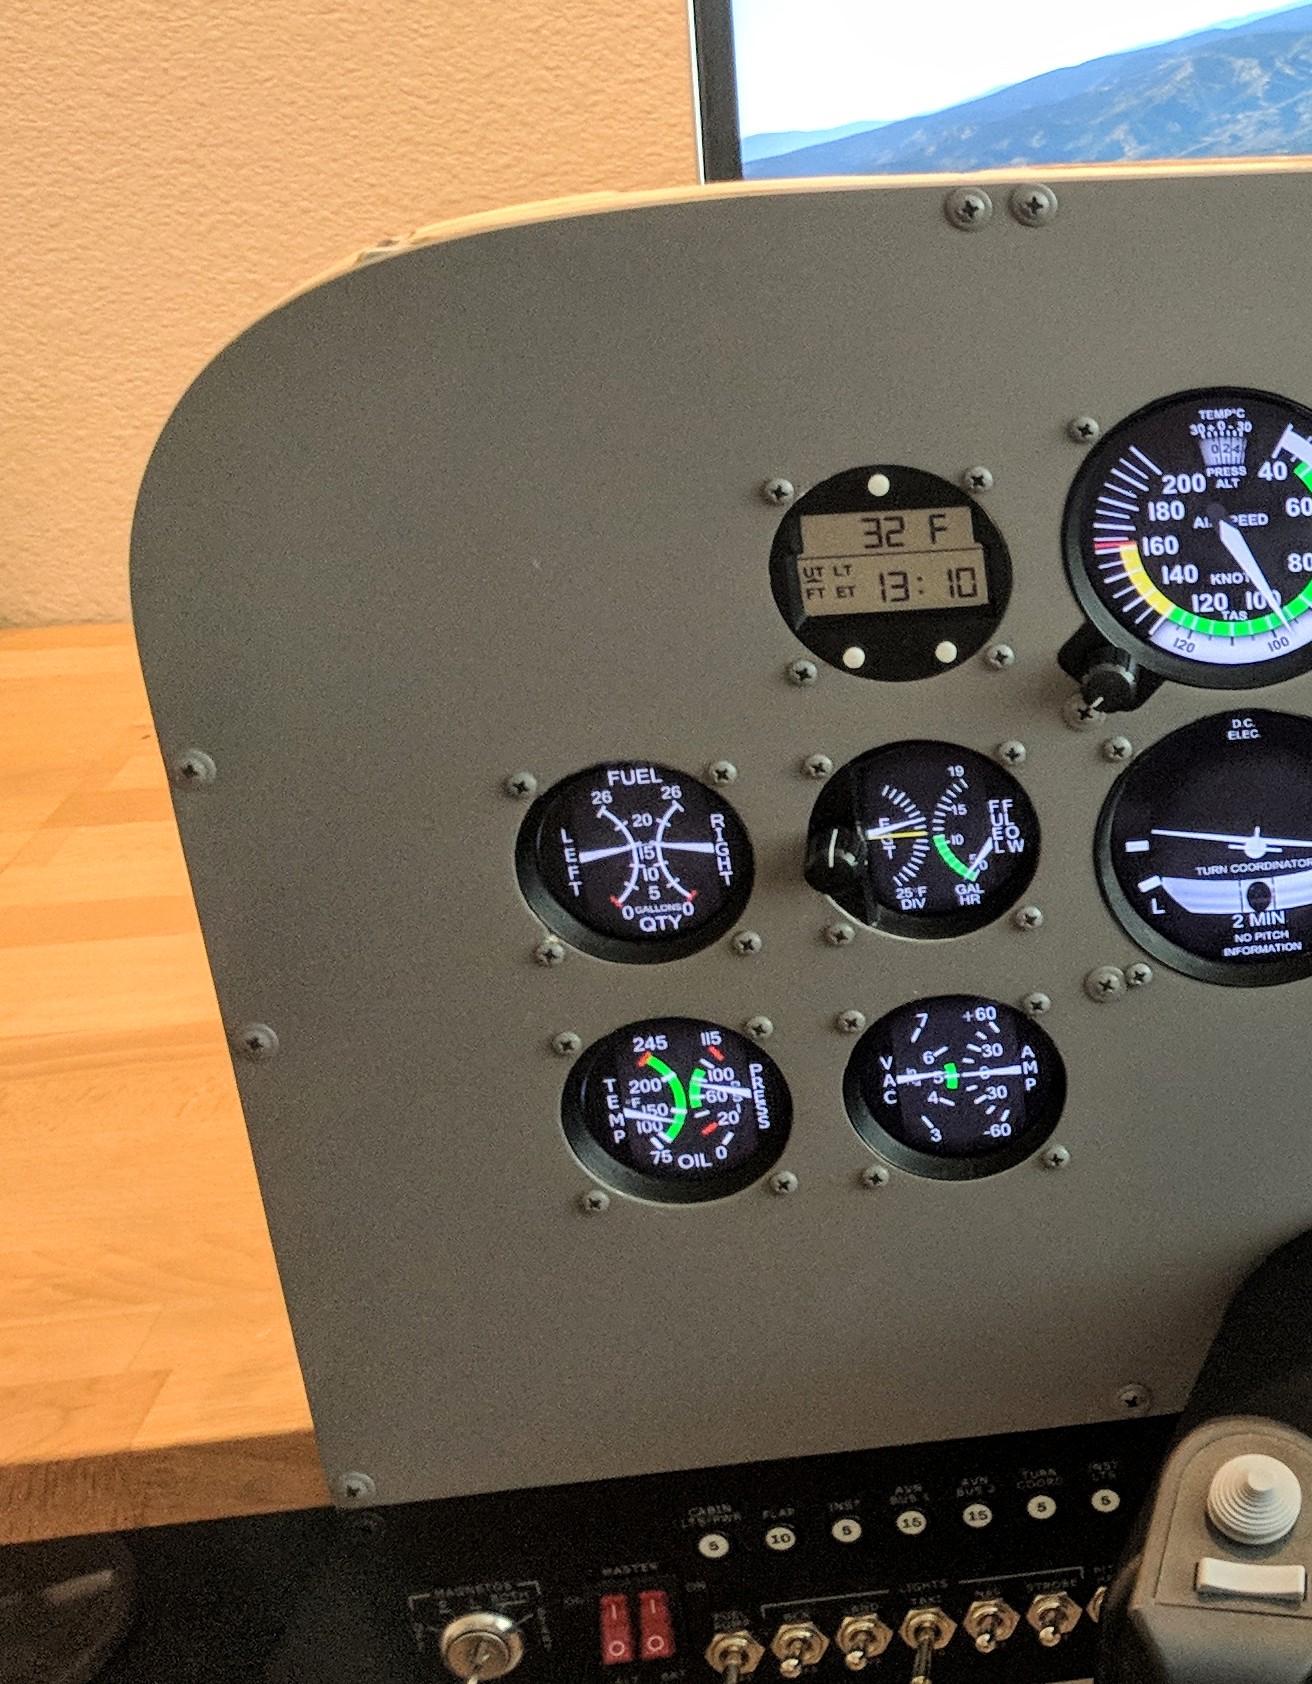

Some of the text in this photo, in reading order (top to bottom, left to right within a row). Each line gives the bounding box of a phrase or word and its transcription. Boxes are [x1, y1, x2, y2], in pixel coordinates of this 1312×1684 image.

[1206, 466, 1247, 477] PRESS
[1257, 460, 1287, 481] 40
[1162, 473, 1207, 495] 200
[1216, 478, 1240, 489] ALT
[1148, 500, 1185, 522] 180
[862, 514, 948, 549] 32 F
[1142, 535, 1179, 557] 160
[803, 565, 852, 579] UT LT
[1161, 563, 1199, 585] 140
[807, 585, 855, 600] FT ET
[1192, 592, 1229, 613] 120
[1222, 610, 1248, 621] TAS
[607, 768, 663, 787] FUEL
[948, 765, 965, 778] 19
[591, 790, 613, 805] 26
[660, 785, 682, 800] 26
[631, 812, 652, 828] 20
[710, 813, 733, 886] RIGHT
[560, 828, 583, 897] LEFT
[1196, 864, 1228, 876] TURN
[955, 883, 985, 896] GAL
[902, 899, 926, 911] DIV
[959, 894, 981, 906] HR
[1151, 898, 1166, 915] L
[634, 903, 682, 915] GALLONS
[639, 914, 682, 932] QTY
[1232, 910, 1286, 929] 2 MIN
[1234, 929, 1290, 943] NO PITCH
[1223, 941, 1302, 957] INFORMATION
[633, 1035, 669, 1053] 245
[700, 1030, 722, 1046] 115
[1021, 1044, 1039, 1092] AMP
[629, 1077, 663, 1095] 200
[879, 1055, 898, 1105] VAC
[749, 1062, 771, 1130] PRESS
[603, 1078, 626, 1144] TEMP
[650, 1149, 673, 1165] 75
[677, 1152, 713, 1170] OIL
[968, 1510, 988, 1521] 15
[770, 1533, 791, 1545] 10
